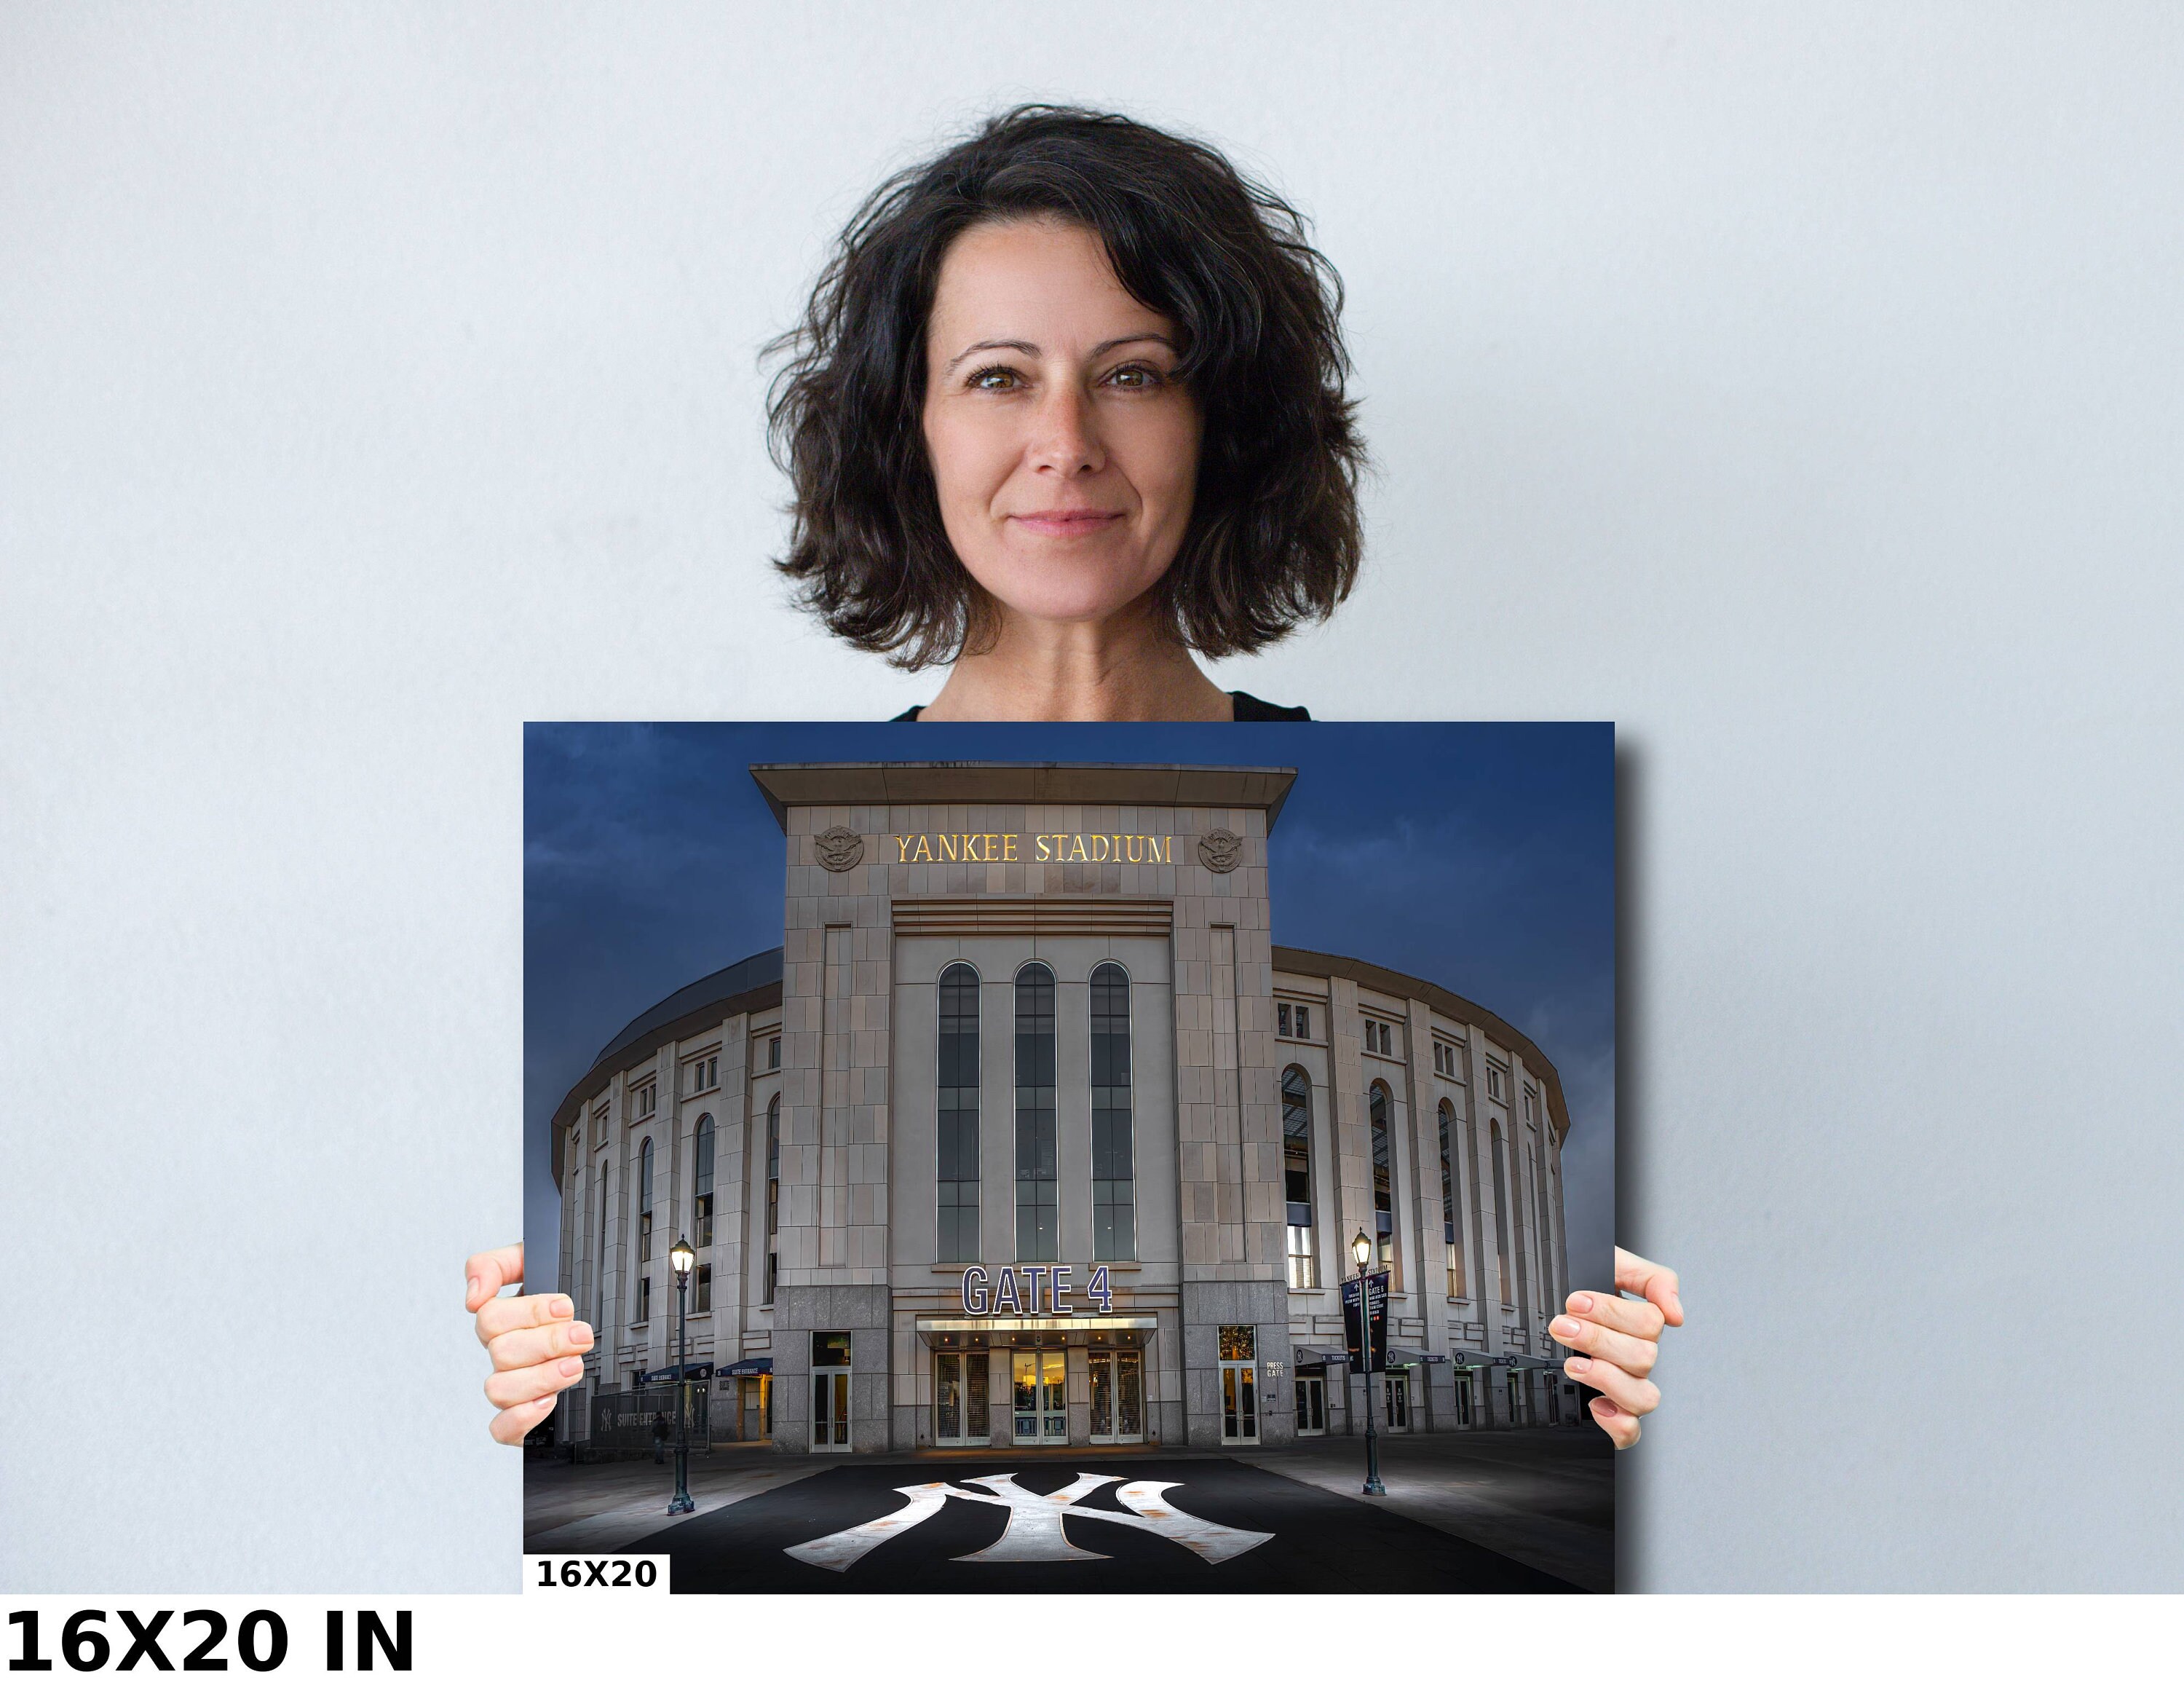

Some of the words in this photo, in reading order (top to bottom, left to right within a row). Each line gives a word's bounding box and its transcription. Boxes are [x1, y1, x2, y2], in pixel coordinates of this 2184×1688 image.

[895, 834, 1018, 862] YANKEE
[1035, 834, 1172, 863] STADIUM
[962, 1265, 1073, 1315] GATE
[1087, 1265, 1113, 1314] 4
[1369, 1286, 1380, 1295] GATE
[1267, 1362, 1283, 1370] PRESS
[1267, 1369, 1283, 1377] GATE
[617, 1413, 637, 1427] SUITE
